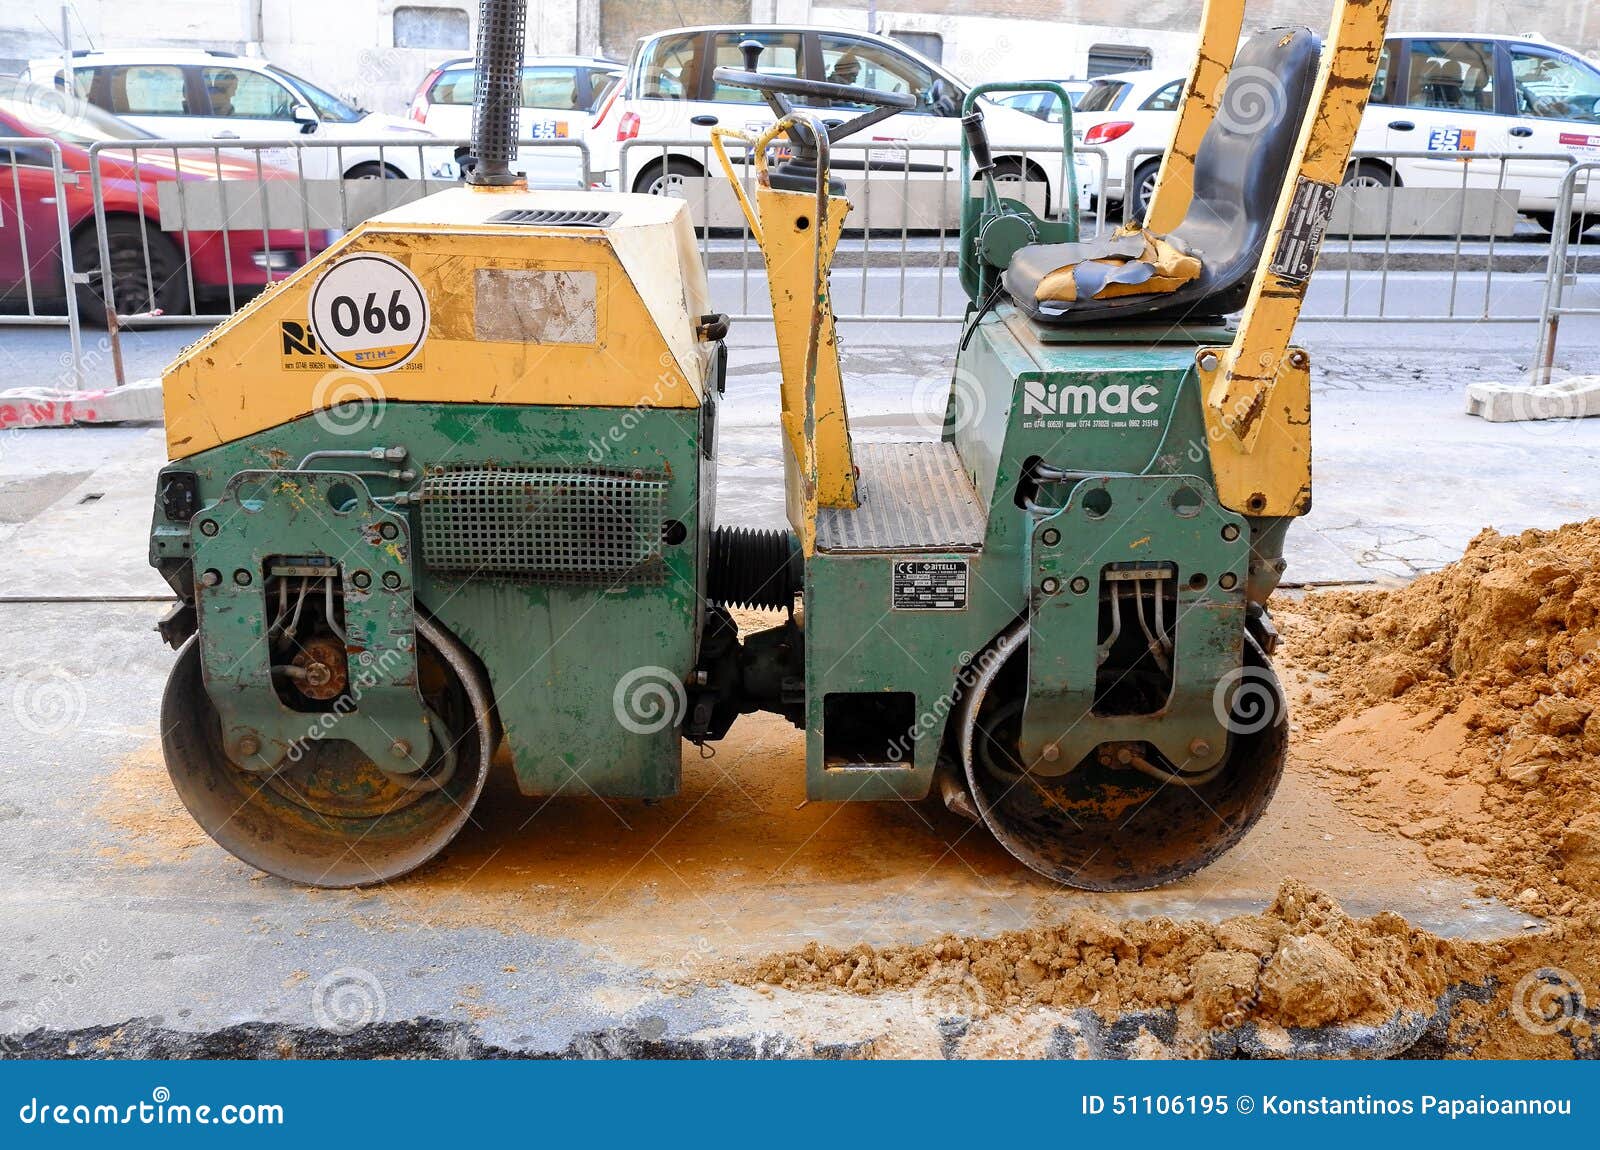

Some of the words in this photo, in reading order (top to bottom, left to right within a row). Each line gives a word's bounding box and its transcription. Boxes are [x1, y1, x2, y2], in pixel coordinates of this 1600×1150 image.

[1431, 129, 1460, 145] 35
[330, 289, 411, 337] 066
[1023, 381, 1160, 415] Rimac
